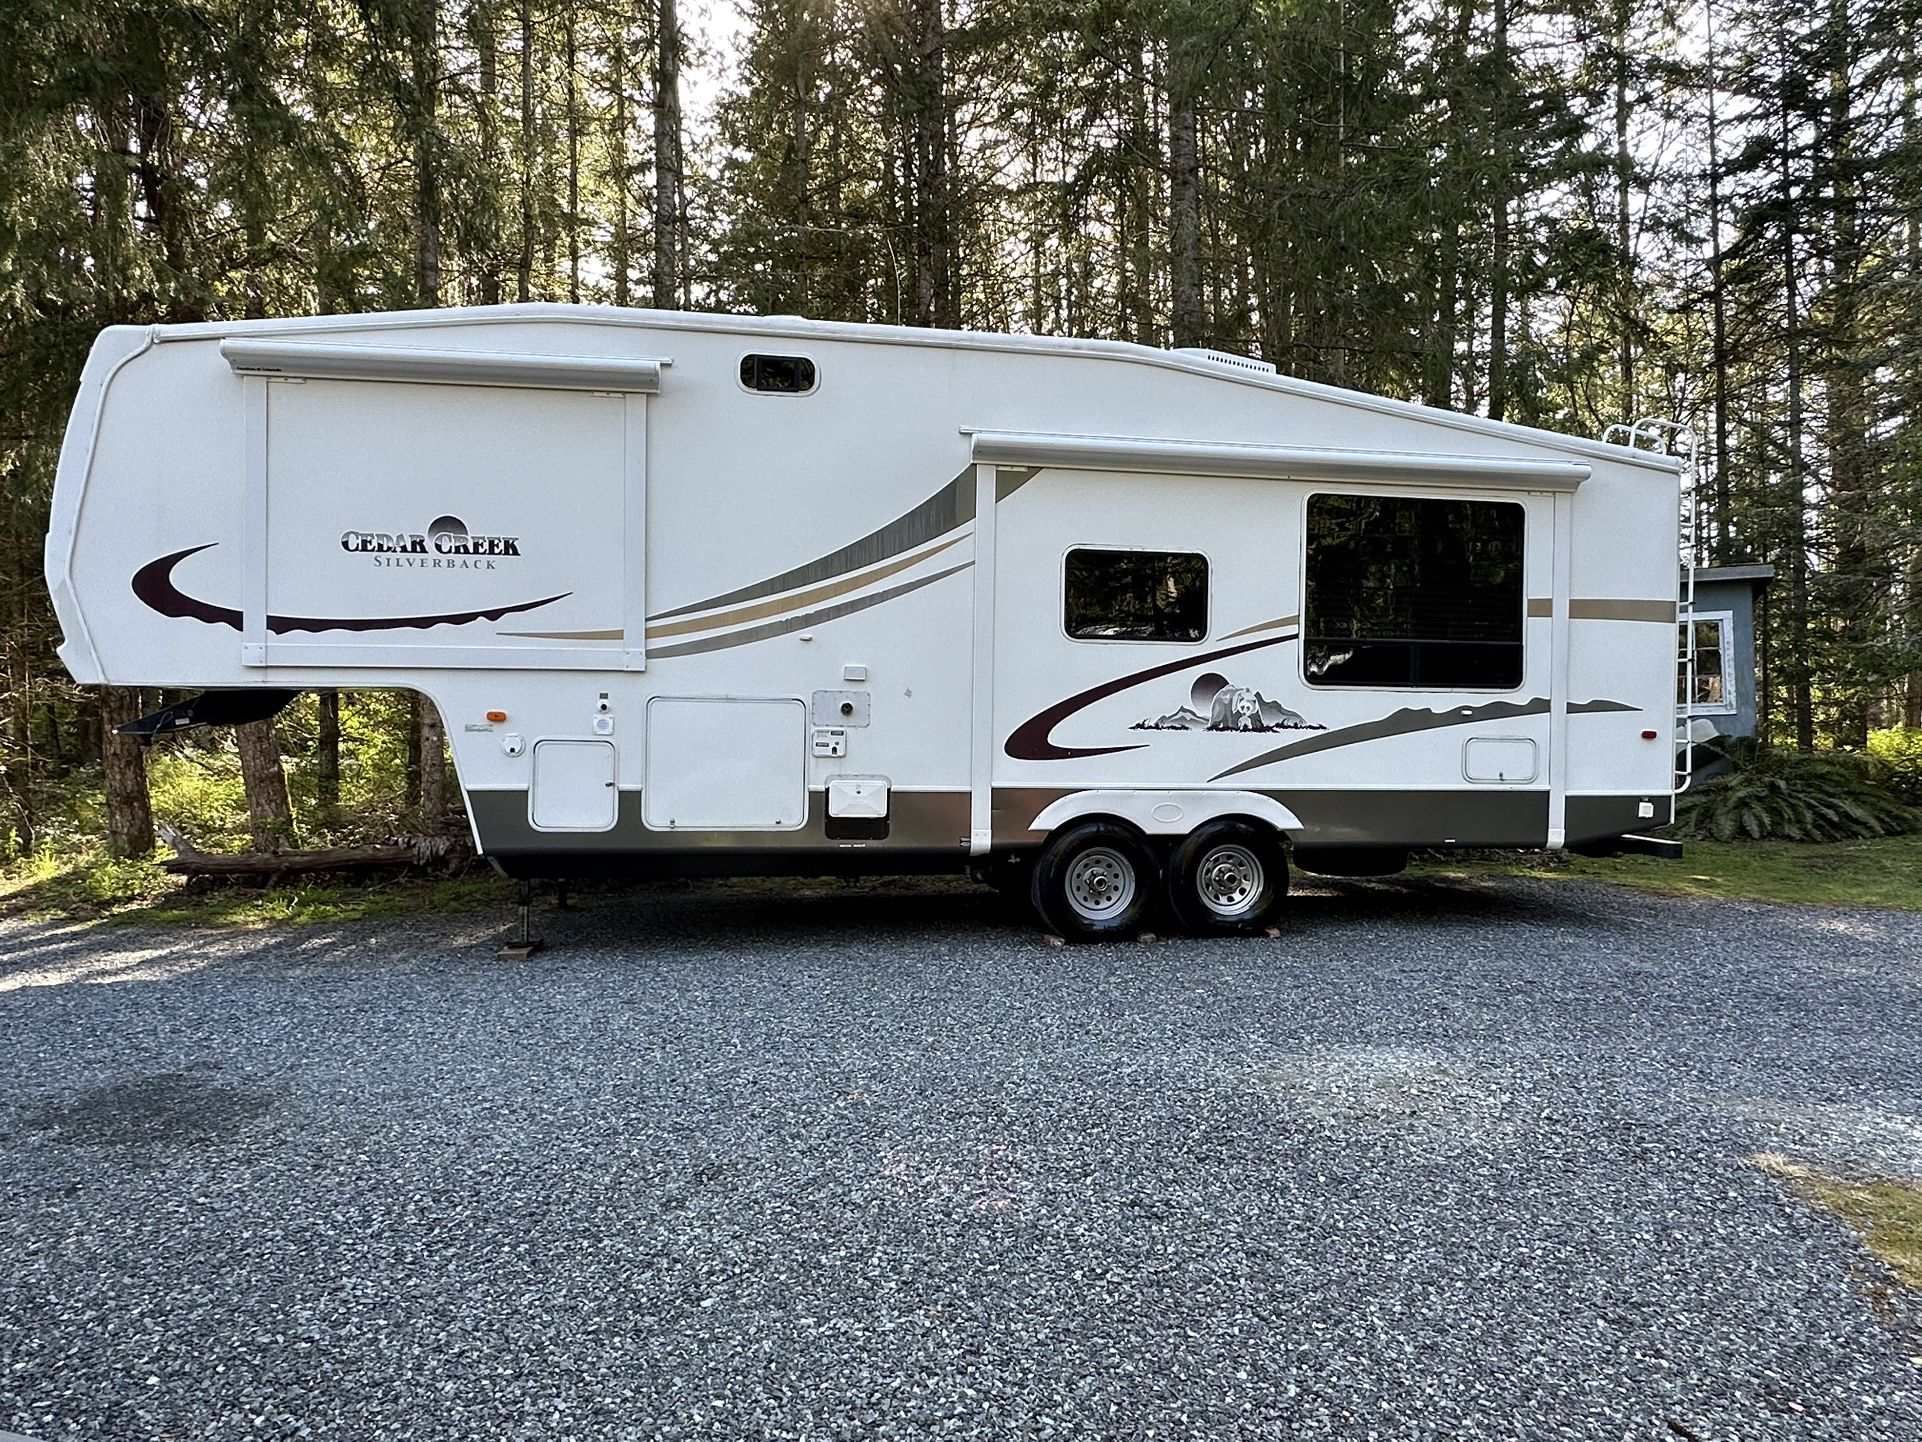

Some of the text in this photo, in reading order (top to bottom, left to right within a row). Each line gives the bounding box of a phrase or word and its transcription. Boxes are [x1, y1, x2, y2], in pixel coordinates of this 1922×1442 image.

[341, 530, 521, 556] CEDAR CREEK
[374, 556, 497, 570] SILVERBACK
